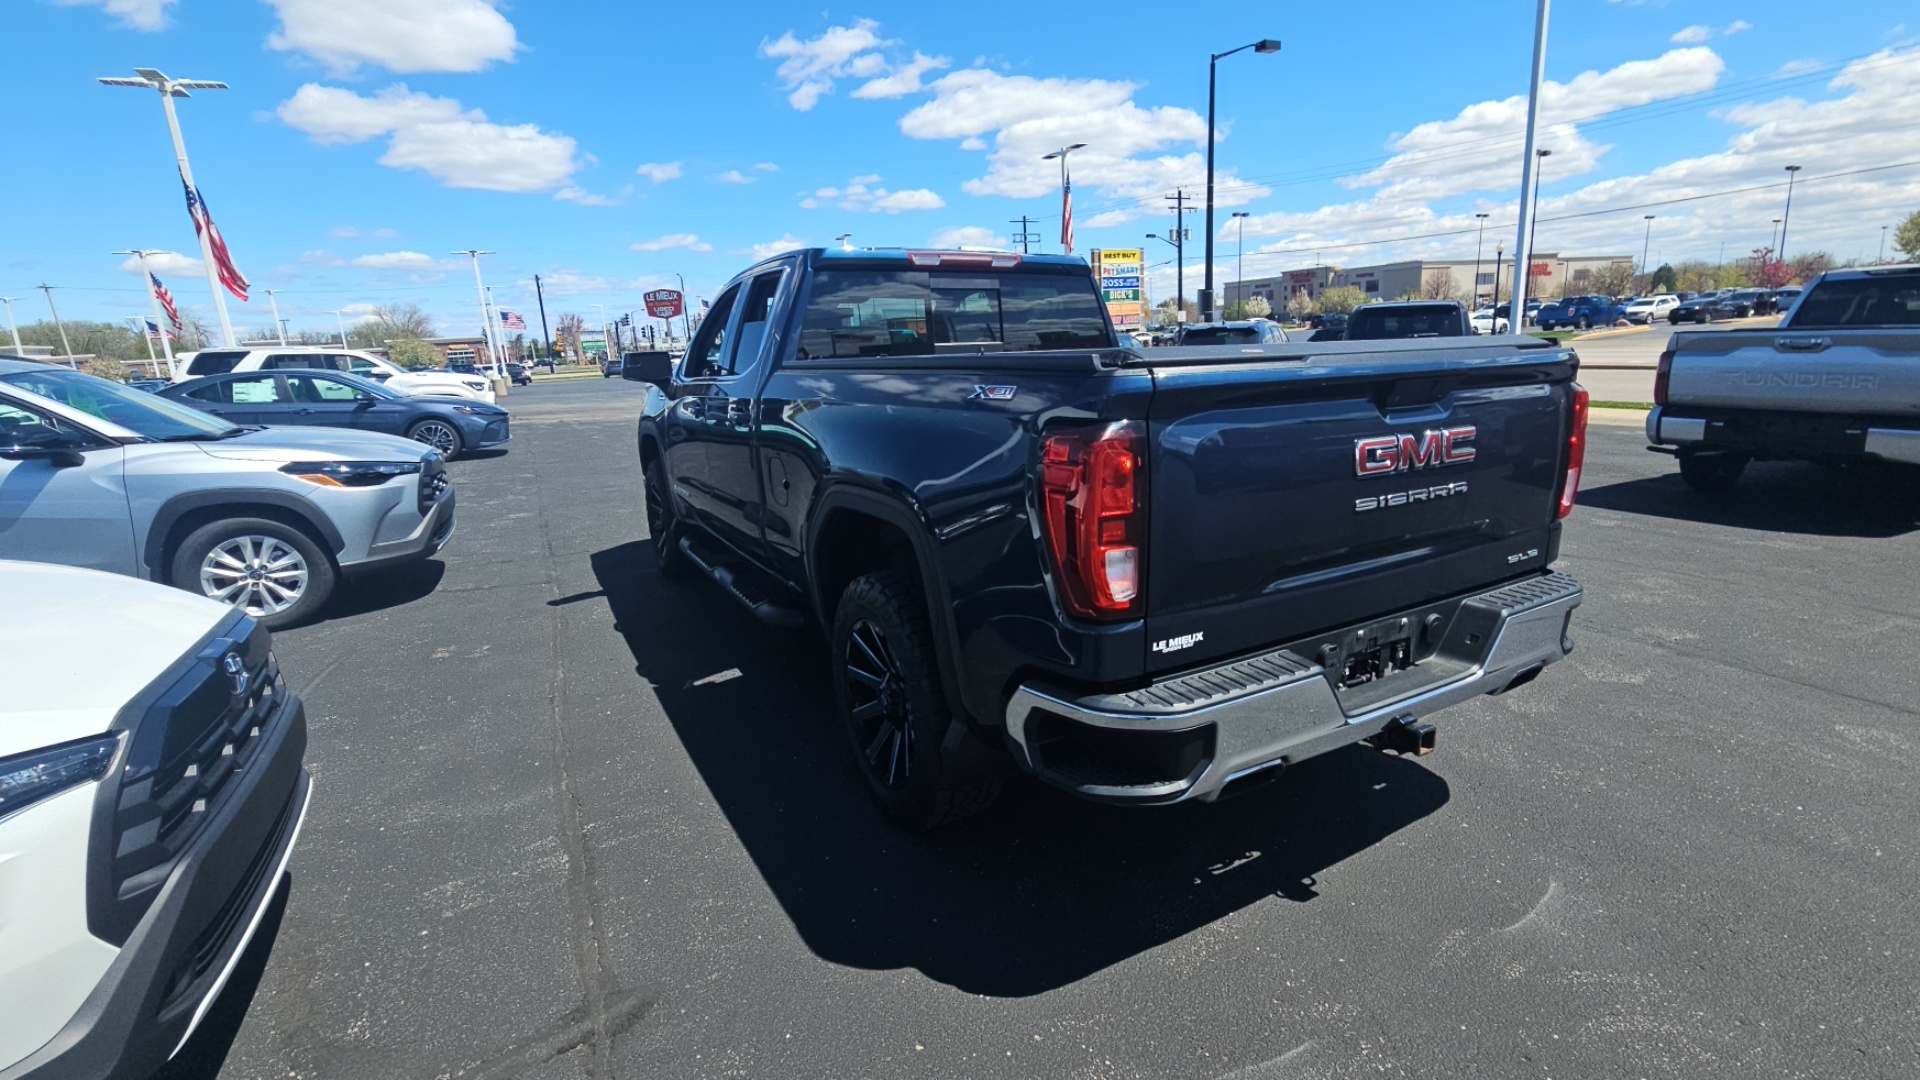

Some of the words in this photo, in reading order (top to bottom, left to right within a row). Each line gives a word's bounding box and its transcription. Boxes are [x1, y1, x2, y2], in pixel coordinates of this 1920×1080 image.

[1103, 279, 1124, 287] ROSS
[656, 291, 678, 300] MIEUX
[1109, 290, 1133, 300] DICK'S
[1721, 371, 1883, 389] TUNDRA
[1355, 425, 1476, 476] GMC
[1355, 481, 1468, 511] SIERRA
[1153, 640, 1166, 651] LE
[1169, 631, 1203, 648] MIEUX
